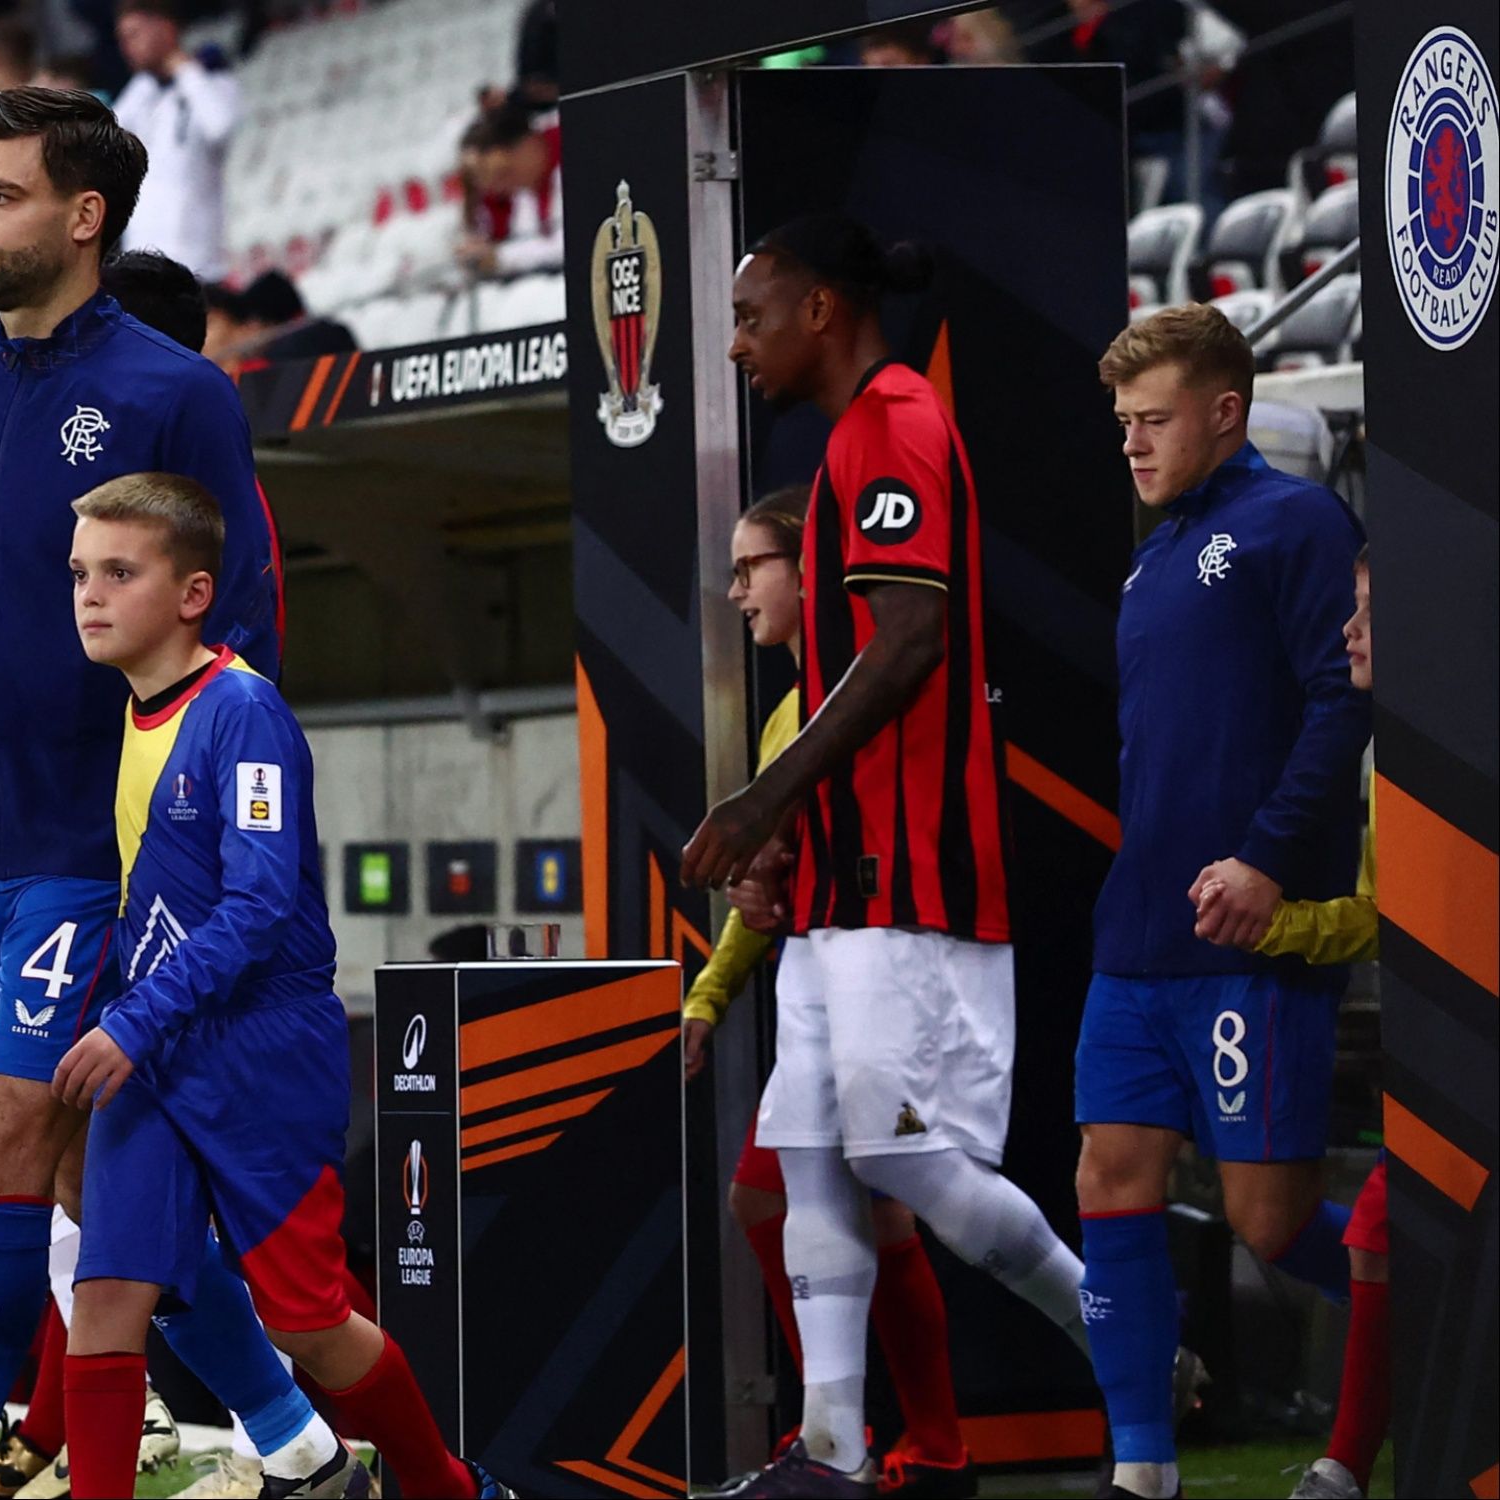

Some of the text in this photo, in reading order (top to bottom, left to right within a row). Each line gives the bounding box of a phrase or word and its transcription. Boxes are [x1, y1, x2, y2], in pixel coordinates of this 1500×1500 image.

[1400, 46, 1490, 138] RANGERS
[611, 256, 640, 289] OGC
[1397, 208, 1498, 328] FOOTBALL CLUB
[1432, 260, 1464, 286] READY
[612, 285, 641, 316] NICE
[391, 353, 440, 403] UEFA
[441, 340, 514, 396] EUROPA
[860, 492, 915, 531] JD
[168, 807, 199, 815] EUROPA
[20, 921, 78, 999] 4
[11, 1025, 49, 1038] CASTORE
[1212, 1010, 1249, 1088] 8
[393, 1074, 436, 1092] DECATHLON
[398, 1247, 434, 1267] EUROPA
[401, 1268, 432, 1285] LEAGUE
